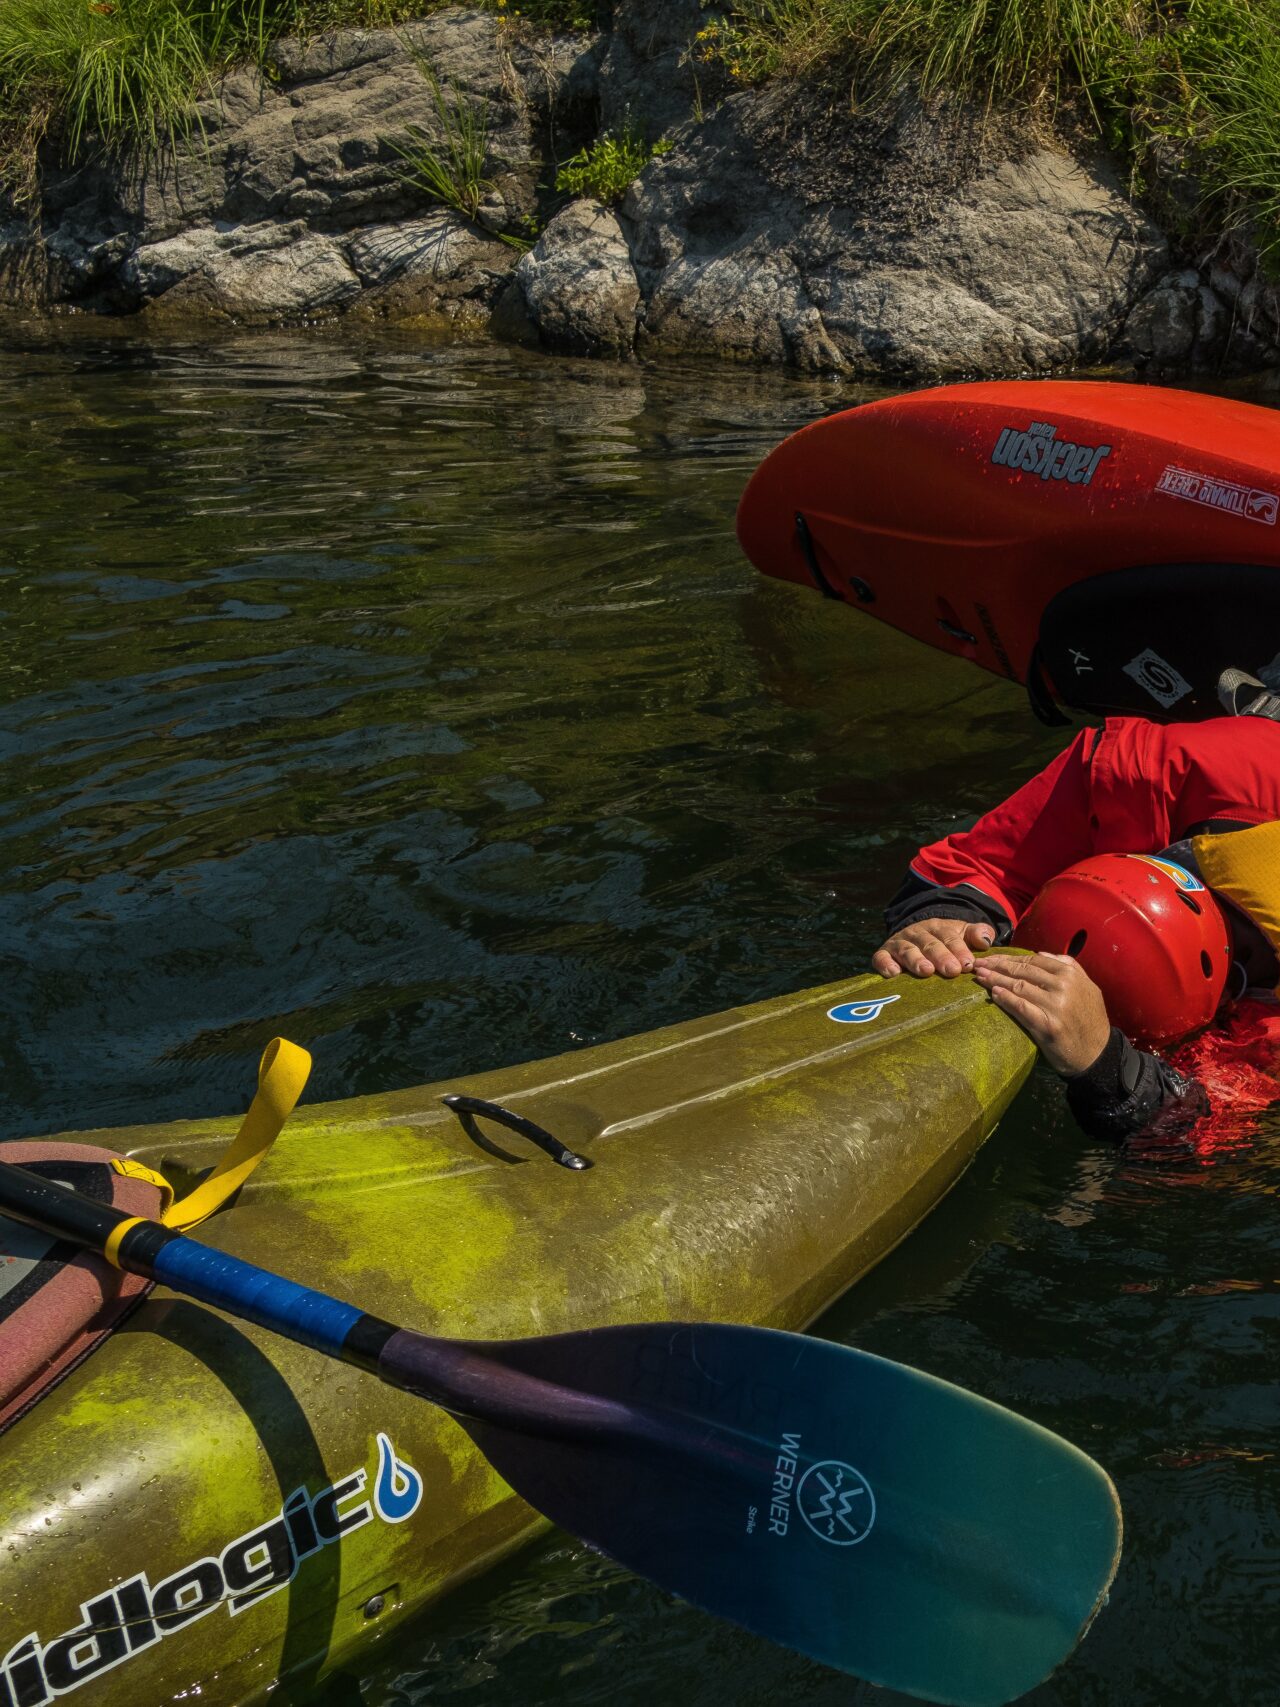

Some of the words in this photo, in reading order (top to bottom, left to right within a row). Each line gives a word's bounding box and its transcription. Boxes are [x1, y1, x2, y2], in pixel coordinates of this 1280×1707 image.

[991, 428, 1112, 485] jackson
[1200, 482, 1245, 513] TUMALO
[768, 1432, 802, 1537] WERNER
[745, 1505, 758, 1534] Strike
[0, 1469, 374, 1707] idlogic
